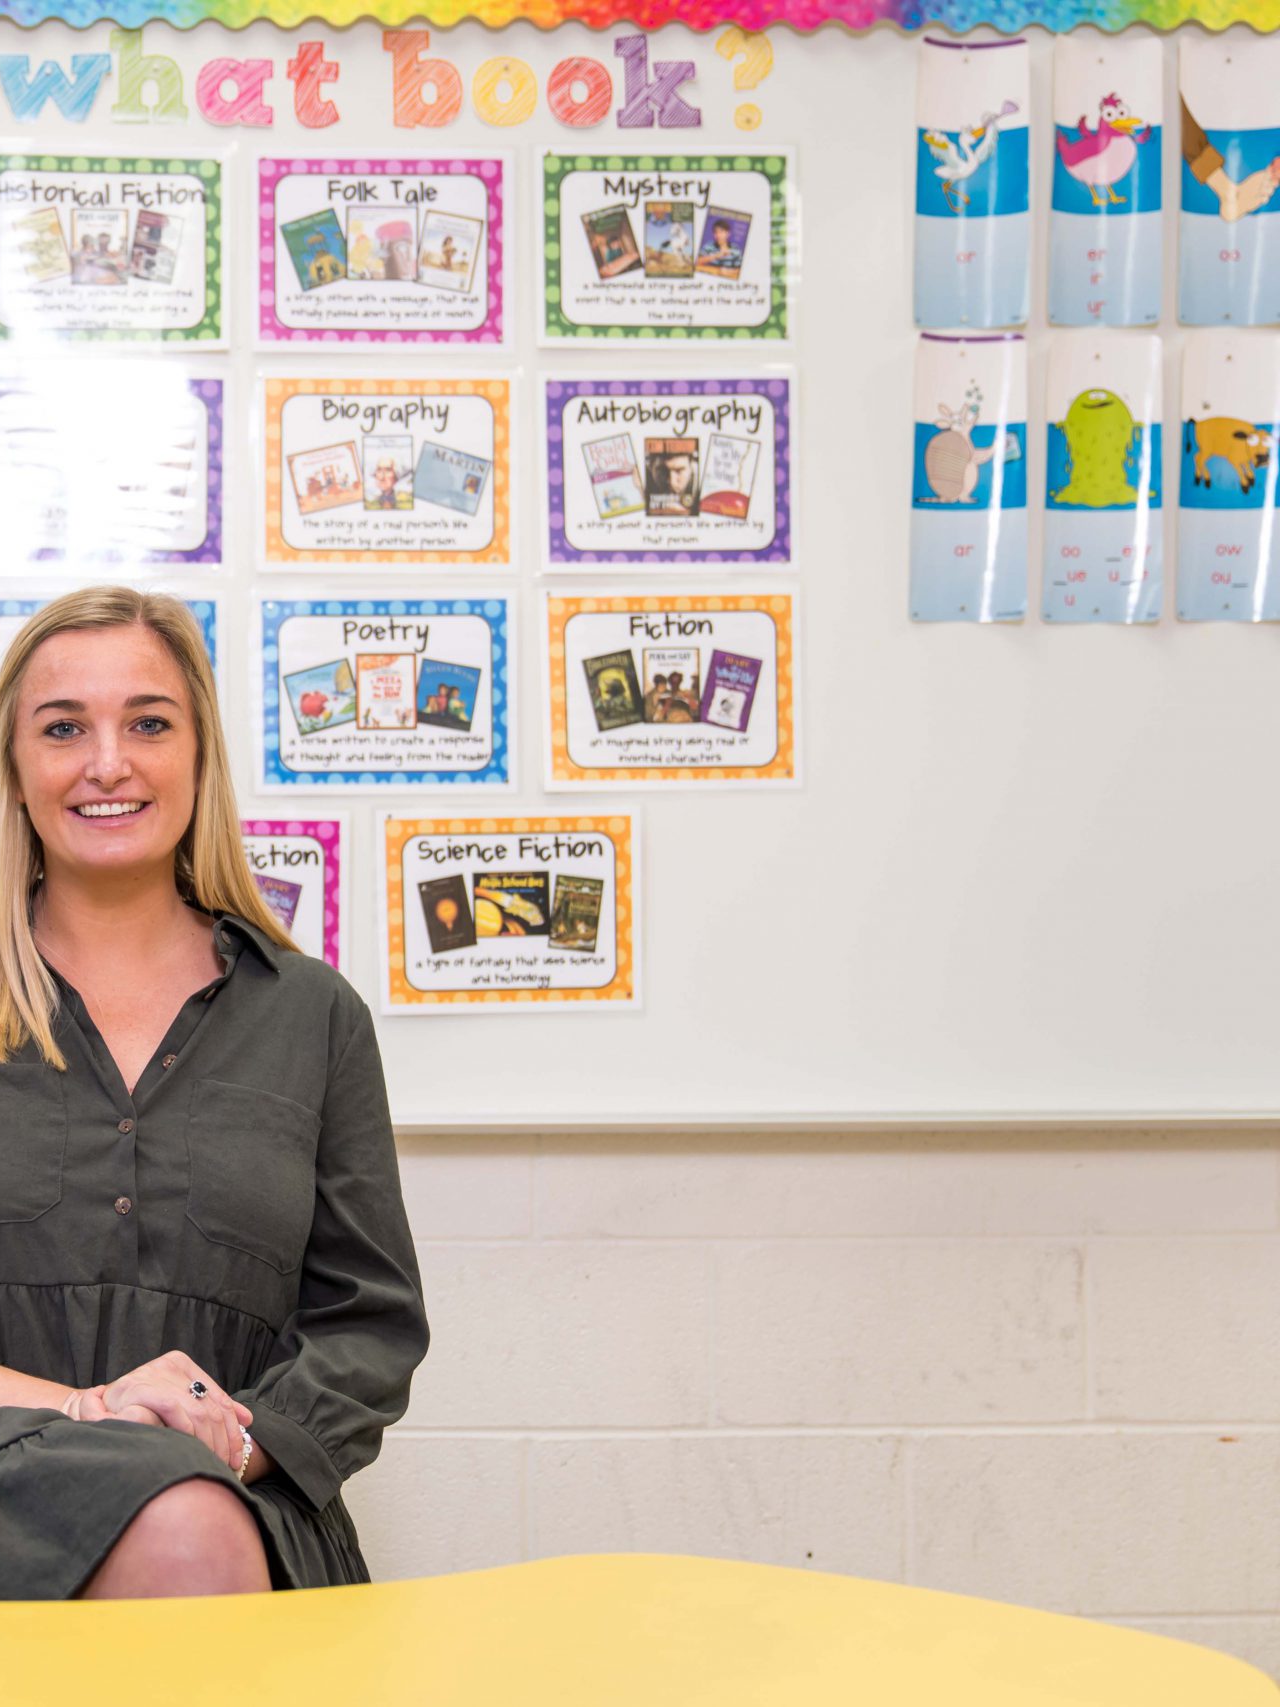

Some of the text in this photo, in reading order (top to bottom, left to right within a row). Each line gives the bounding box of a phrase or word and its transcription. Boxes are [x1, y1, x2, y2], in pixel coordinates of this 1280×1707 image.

[383, 28, 774, 131] book?
[121, 183, 207, 206] Fiction
[328, 180, 438, 205] Folk Tale
[604, 174, 710, 208] Mystery
[322, 398, 449, 433] Biography
[577, 400, 762, 437] Autobiography
[343, 617, 429, 653] Poetry
[630, 615, 712, 639] Fiction
[243, 844, 319, 870] iction
[417, 836, 603, 864] Science Fiction
[416, 961, 422, 969] a
[427, 958, 448, 972] type
[454, 958, 464, 966] of
[470, 956, 511, 970] fantasy
[516, 956, 537, 966] that
[570, 956, 605, 966] science
[472, 974, 551, 988] and technology
